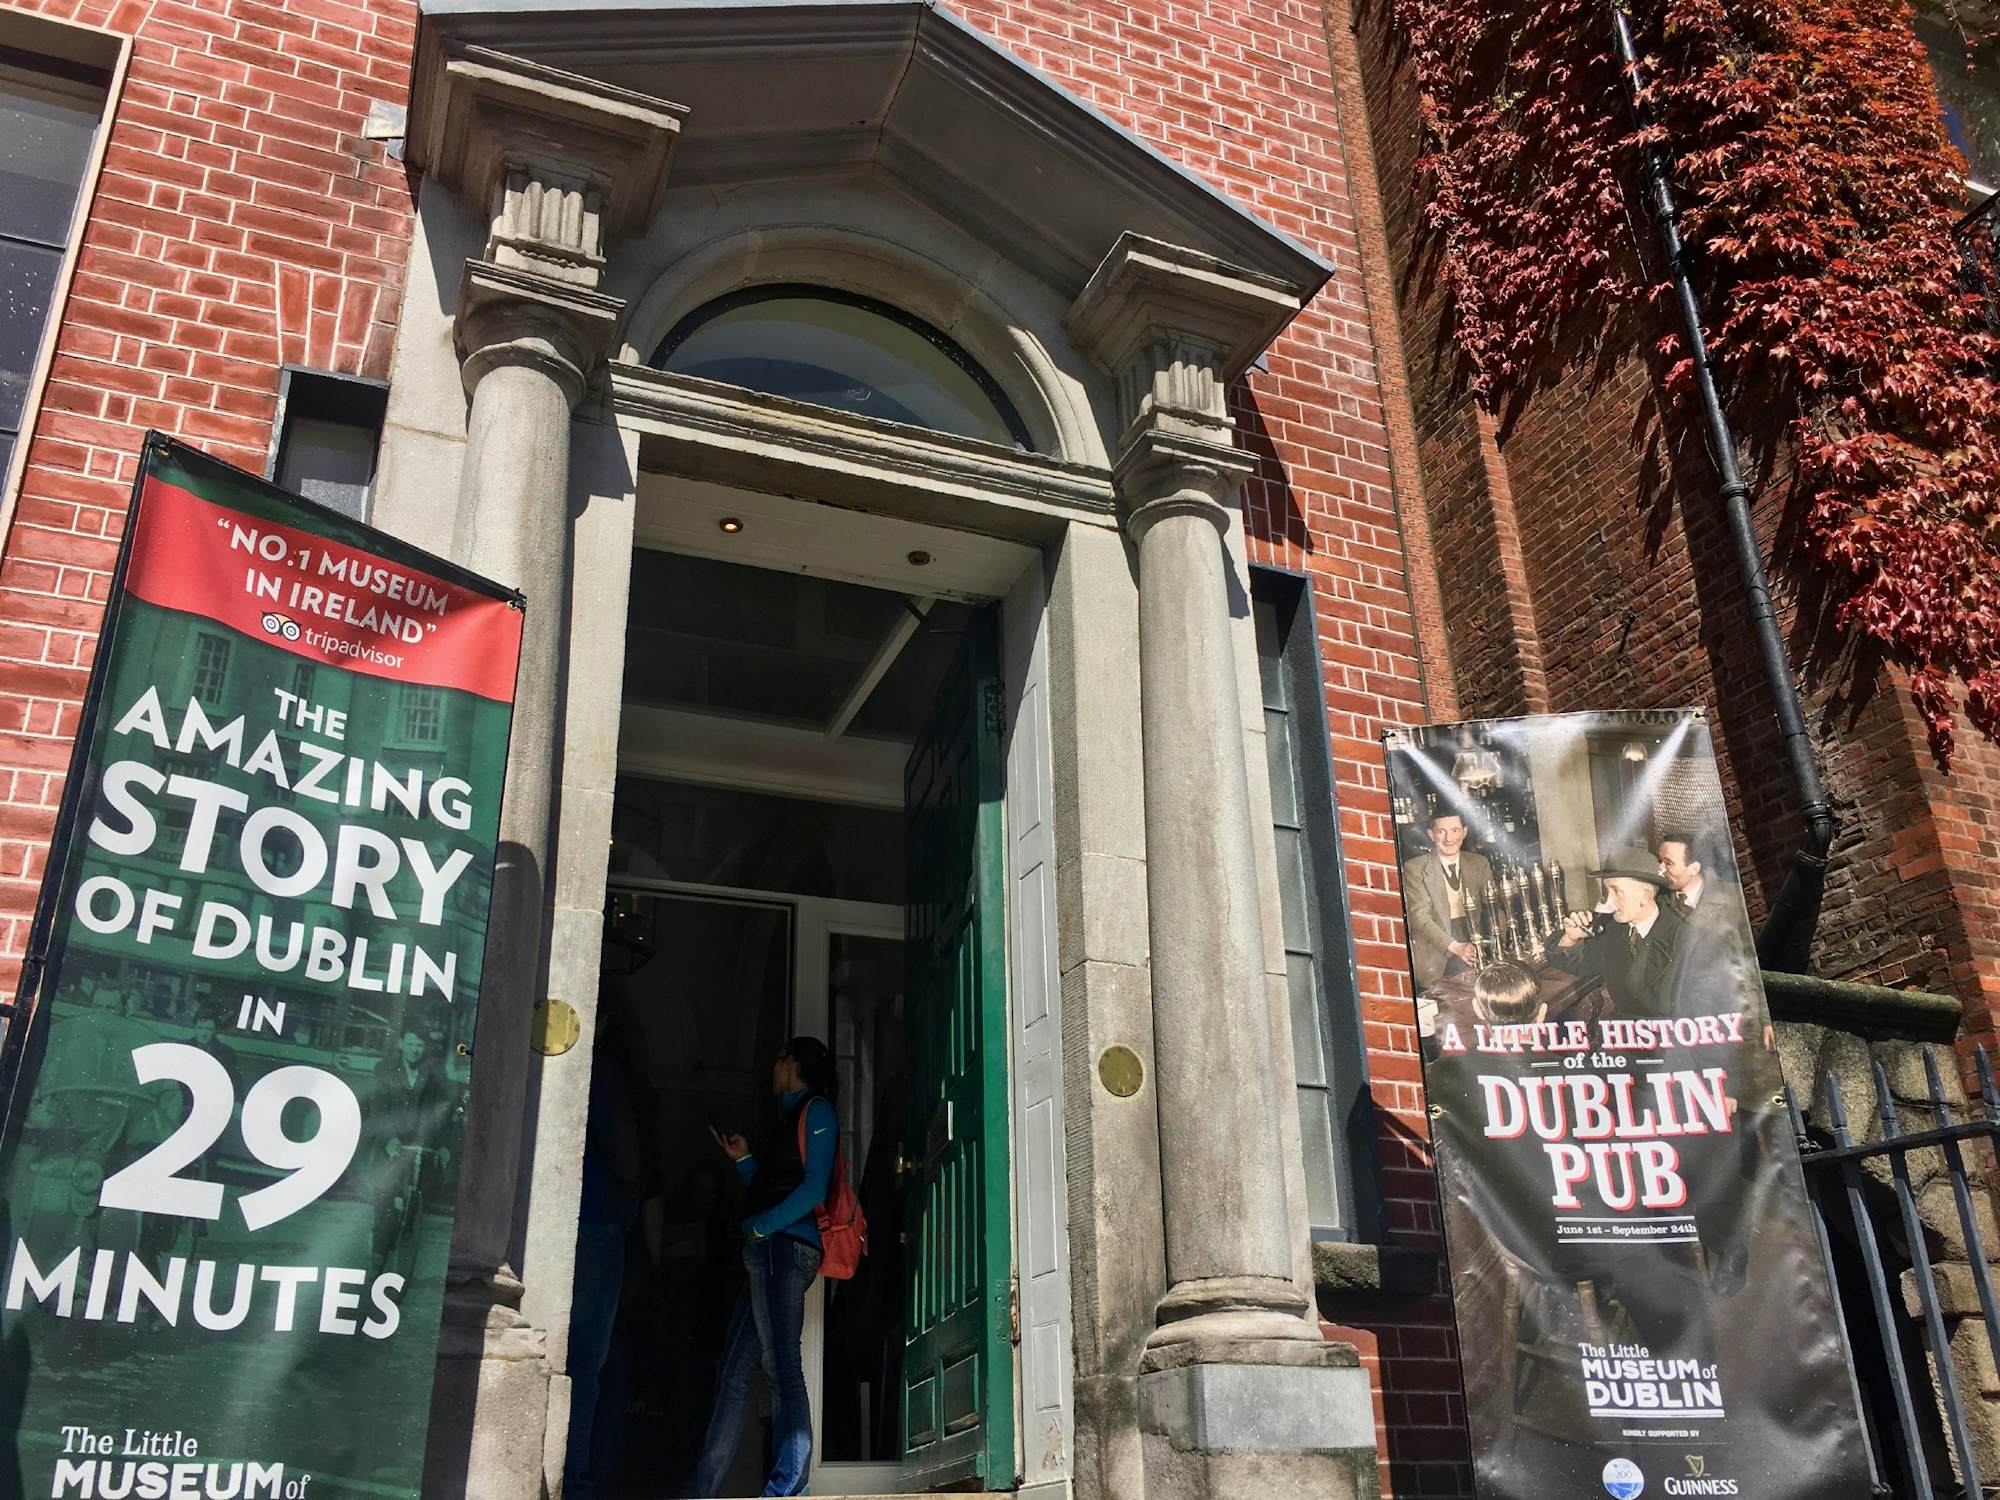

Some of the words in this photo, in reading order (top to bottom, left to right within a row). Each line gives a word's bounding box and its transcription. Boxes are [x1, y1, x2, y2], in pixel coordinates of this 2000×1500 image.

[318, 551, 449, 616] MUSEUM
[246, 568, 282, 602] IN
[289, 582, 437, 644] IRELAND”
[305, 628, 404, 668] tripadvisor
[274, 688, 347, 740] THE
[114, 685, 472, 830] AMAZING
[87, 761, 474, 925] STORY
[75, 876, 182, 944] OF
[192, 902, 457, 1003] DUBLIN
[236, 994, 286, 1035] IN
[1442, 1023, 1467, 1054] A
[1473, 1021, 1591, 1054] LITTLE
[1599, 1012, 1745, 1051] HISTORY
[1563, 1052, 1587, 1069] of
[1591, 1052, 1627, 1068] the
[1477, 1068, 1733, 1142] DUBLIN
[99, 1042, 362, 1231] 29
[1543, 1141, 1688, 1210] PUB
[1556, 1225, 1584, 1235] June
[1587, 1225, 1603, 1235] 1st
[1612, 1225, 1669, 1237] September
[1671, 1223, 1698, 1234] 24th
[4, 1237, 407, 1340] MINUTES
[1578, 1342, 1606, 1358] The
[1608, 1343, 1650, 1358] Little
[1581, 1358, 1701, 1380] MUSEUM
[1702, 1364, 1718, 1380] of
[1585, 1380, 1723, 1408] DUBLIN
[61, 1426, 114, 1455] The
[122, 1429, 198, 1457] Little
[1647, 1429, 1689, 1438] SUPPORTED
[1690, 1429, 1700, 1437] BY
[51, 1458, 285, 1500] MUSEUM
[285, 1474, 312, 1500] of
[1664, 1477, 1739, 1496] GUINNESS
